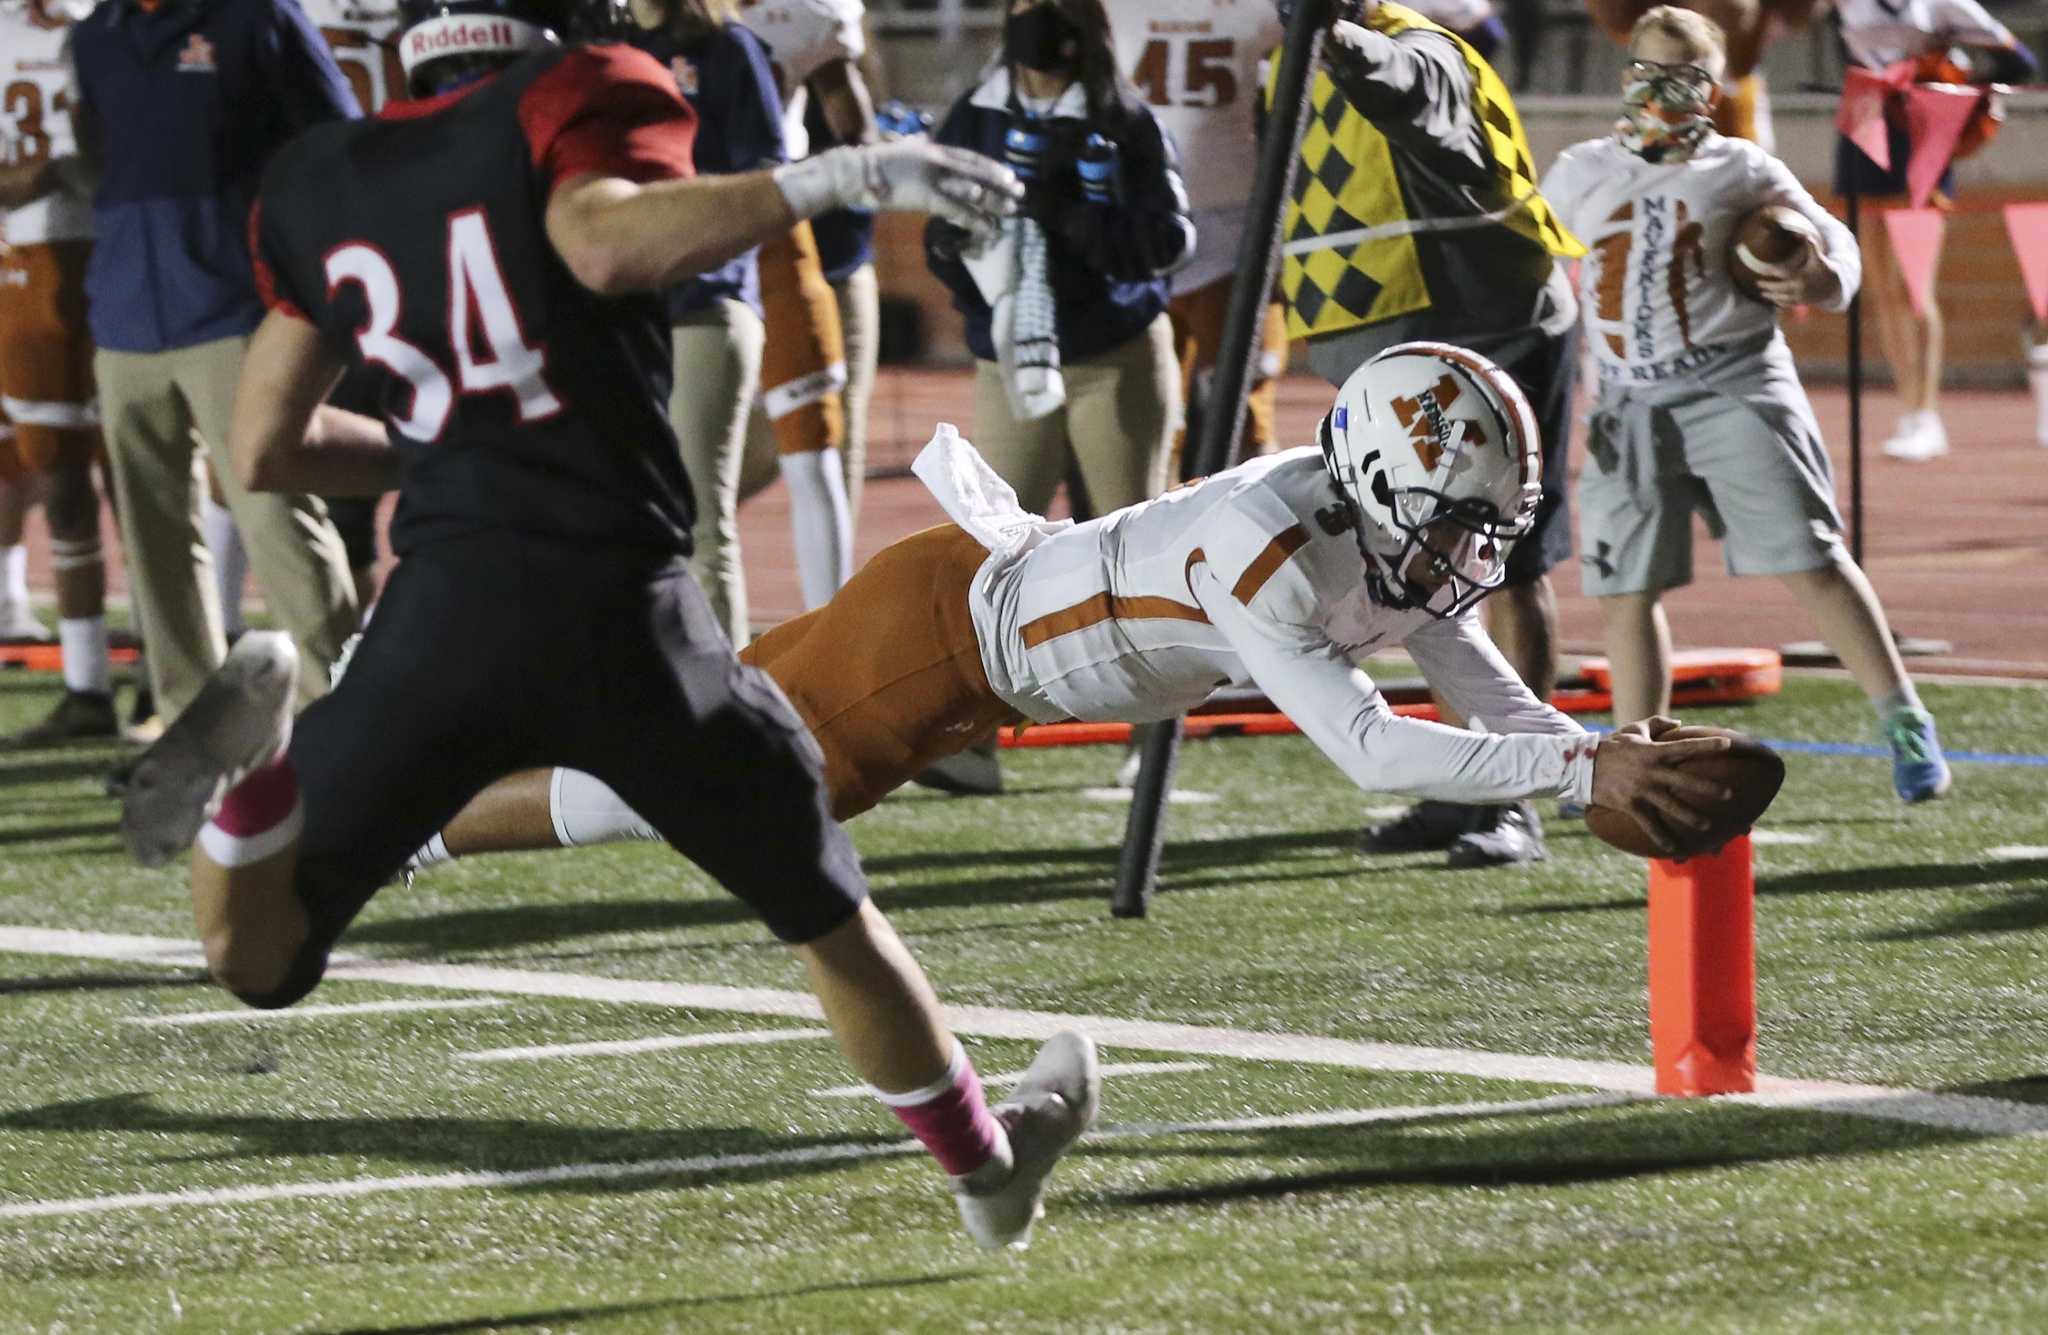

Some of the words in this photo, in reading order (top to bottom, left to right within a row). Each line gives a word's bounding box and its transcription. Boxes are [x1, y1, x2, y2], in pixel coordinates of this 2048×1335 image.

[411, 21, 514, 55] Riddell
[1133, 38, 1238, 107] 45
[323, 205, 564, 444] 34
[1634, 194, 1667, 358] MAVERICKS
